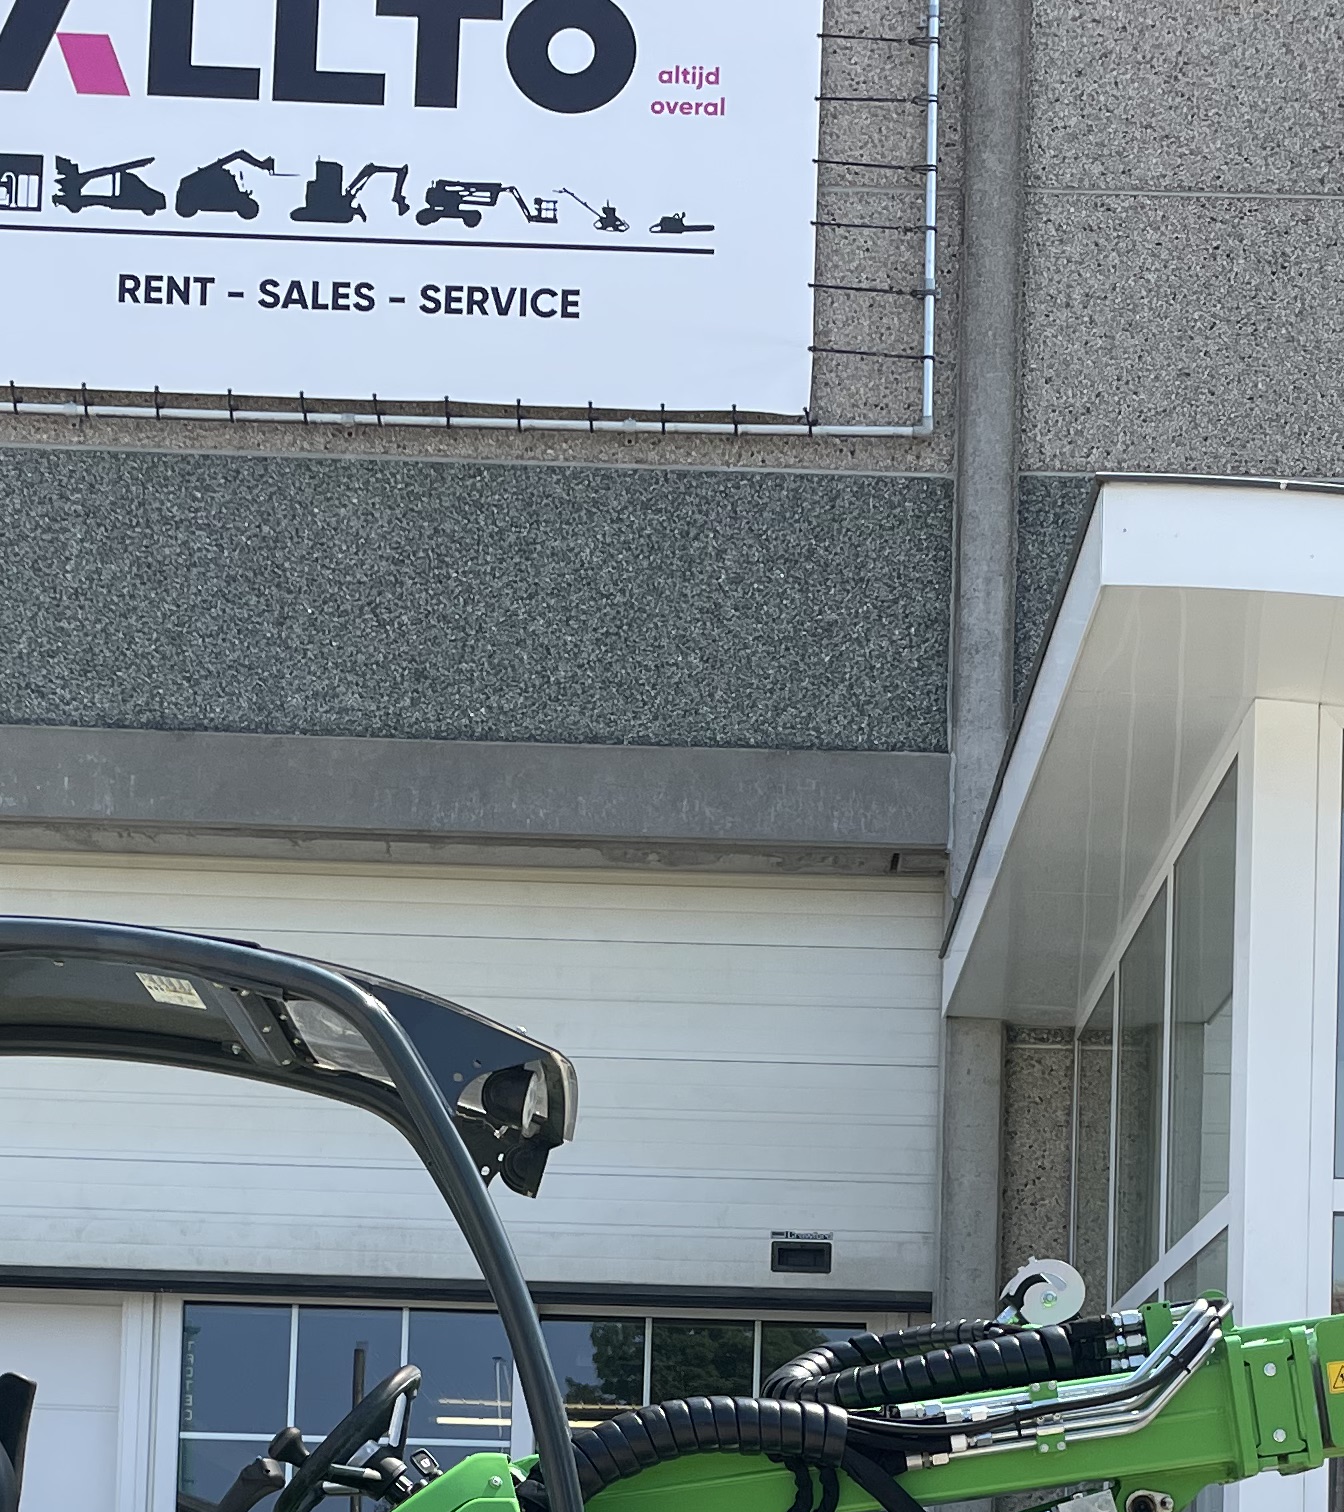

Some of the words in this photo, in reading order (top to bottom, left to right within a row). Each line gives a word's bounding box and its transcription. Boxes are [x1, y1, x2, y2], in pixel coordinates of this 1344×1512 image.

[658, 65, 721, 90] altijd
[650, 97, 726, 117] overal
[117, 273, 216, 307] RENT
[257, 279, 376, 312] SALES
[419, 284, 581, 318] SERVICE
